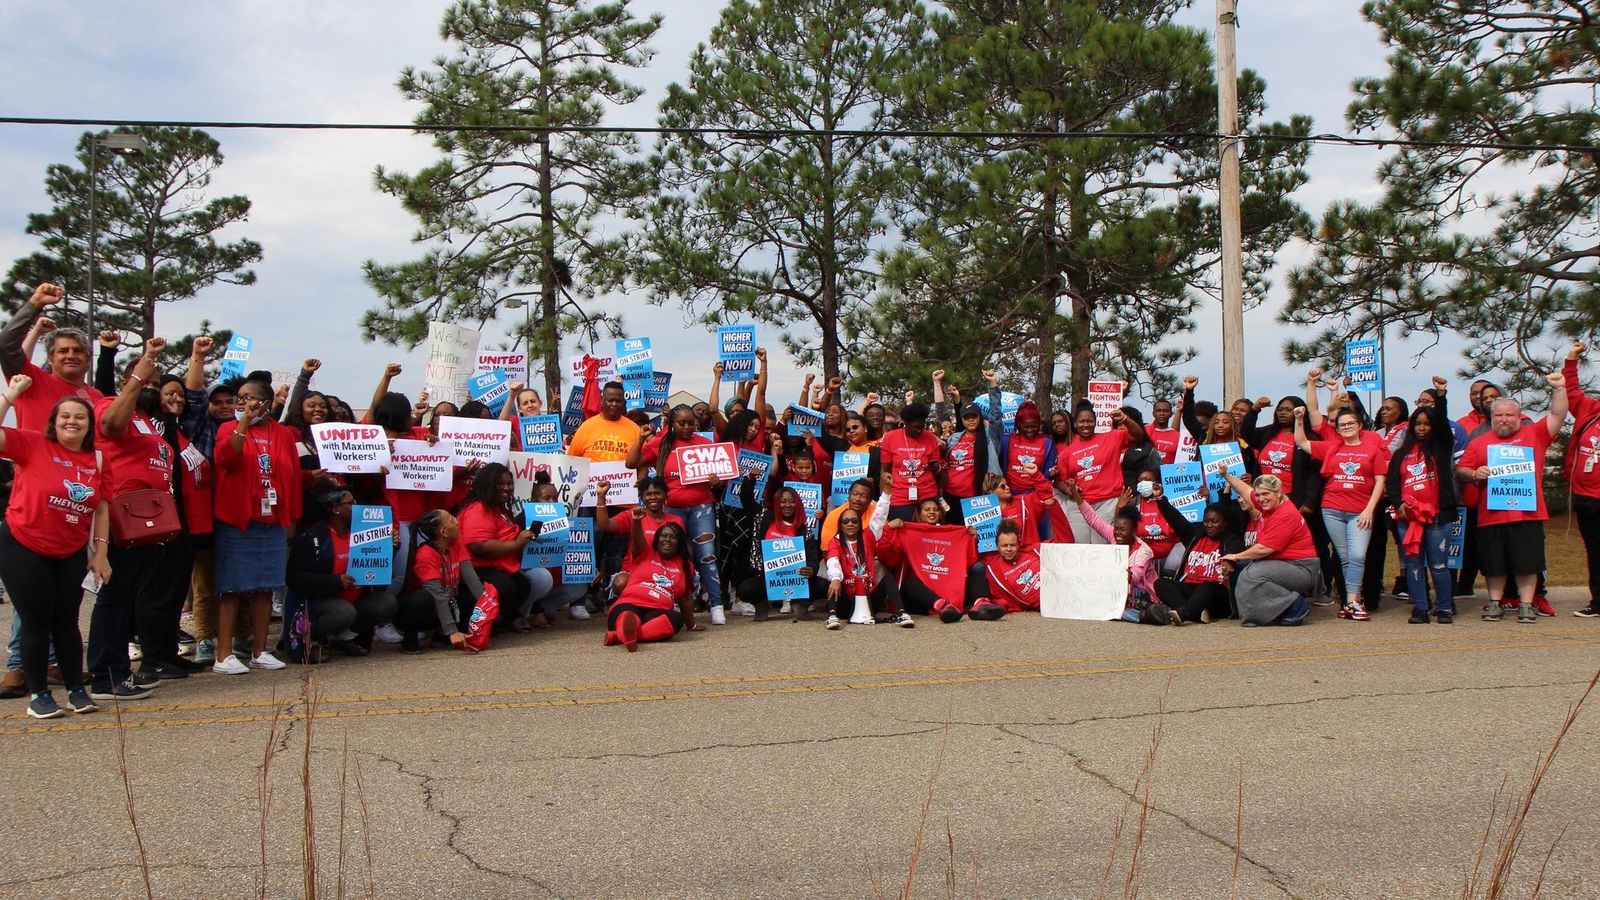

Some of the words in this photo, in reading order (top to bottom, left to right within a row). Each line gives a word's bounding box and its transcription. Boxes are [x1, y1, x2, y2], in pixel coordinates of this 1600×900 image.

[723, 332, 751, 342] HIGHER
[624, 340, 643, 349] CWA
[723, 342, 752, 353] WAGES!
[1350, 345, 1374, 356] HIGHER
[478, 355, 524, 365] UNITED
[619, 356, 629, 365] ON
[630, 350, 650, 362] STRIKE
[1350, 355, 1375, 366] WAGES!
[493, 365, 525, 373] Mximus
[625, 364, 644, 372] against
[725, 359, 752, 371] NOW!
[426, 363, 457, 381] NOT
[621, 371, 651, 381] MAXIMUS
[1351, 370, 1376, 382] NOW!
[476, 373, 498, 387] CWA
[486, 383, 508, 400] STRIKE
[1093, 383, 1116, 392] CWA
[624, 390, 640, 399] OW!
[1089, 394, 1121, 402] FIGHTING
[792, 414, 819, 426] NOW!
[526, 422, 556, 434] HIGHER
[319, 428, 380, 441] UNITED
[440, 432, 453, 440] IN
[453, 433, 508, 441] SOLIDARITY
[527, 433, 557, 446] WAGES!
[322, 442, 340, 451] with
[341, 442, 386, 451] Maximus
[464, 441, 501, 450] Maximus
[592, 446, 628, 454] LOUISIANA
[1209, 444, 1232, 453] CWA
[333, 452, 377, 461] Workers!
[455, 449, 491, 458] Workers!
[682, 446, 730, 464] CWA
[1501, 447, 1525, 457] CWA
[400, 455, 449, 463] SOLIDARITY
[842, 453, 861, 463] CWA
[410, 464, 445, 473] Maximus
[684, 460, 733, 477] STRONG
[740, 457, 768, 471] HIGHER
[1206, 463, 1218, 473] ON
[1222, 455, 1242, 468] TRIKE
[1491, 466, 1504, 476] ON
[1506, 462, 1533, 474] STRIKE
[512, 457, 552, 482] When
[557, 465, 579, 484] We
[835, 469, 844, 478] ON
[845, 466, 866, 477] STRIKE
[402, 472, 437, 481] Workers!
[1164, 473, 1201, 485] MAXIMUS
[1500, 477, 1524, 485] against
[1491, 487, 1533, 497] MAXIMUS
[49, 495, 71, 508] THEY
[970, 497, 991, 508] CWA
[362, 508, 384, 520] CWA
[534, 504, 557, 514] CWA
[967, 515, 978, 525] ON
[978, 508, 1000, 522] STRIKE
[542, 518, 567, 533] STRIKE
[353, 533, 366, 545] ON
[366, 526, 391, 542] STRIKE
[772, 538, 796, 550] CWA
[360, 546, 382, 556] against
[526, 546, 564, 556] MAXIMUS
[352, 558, 389, 568] MAXIMUS
[767, 559, 780, 570] ON
[780, 552, 804, 567] STRIKE
[566, 564, 592, 575] HIGHER
[775, 569, 797, 577] against
[769, 578, 806, 588] MAXIMUS
